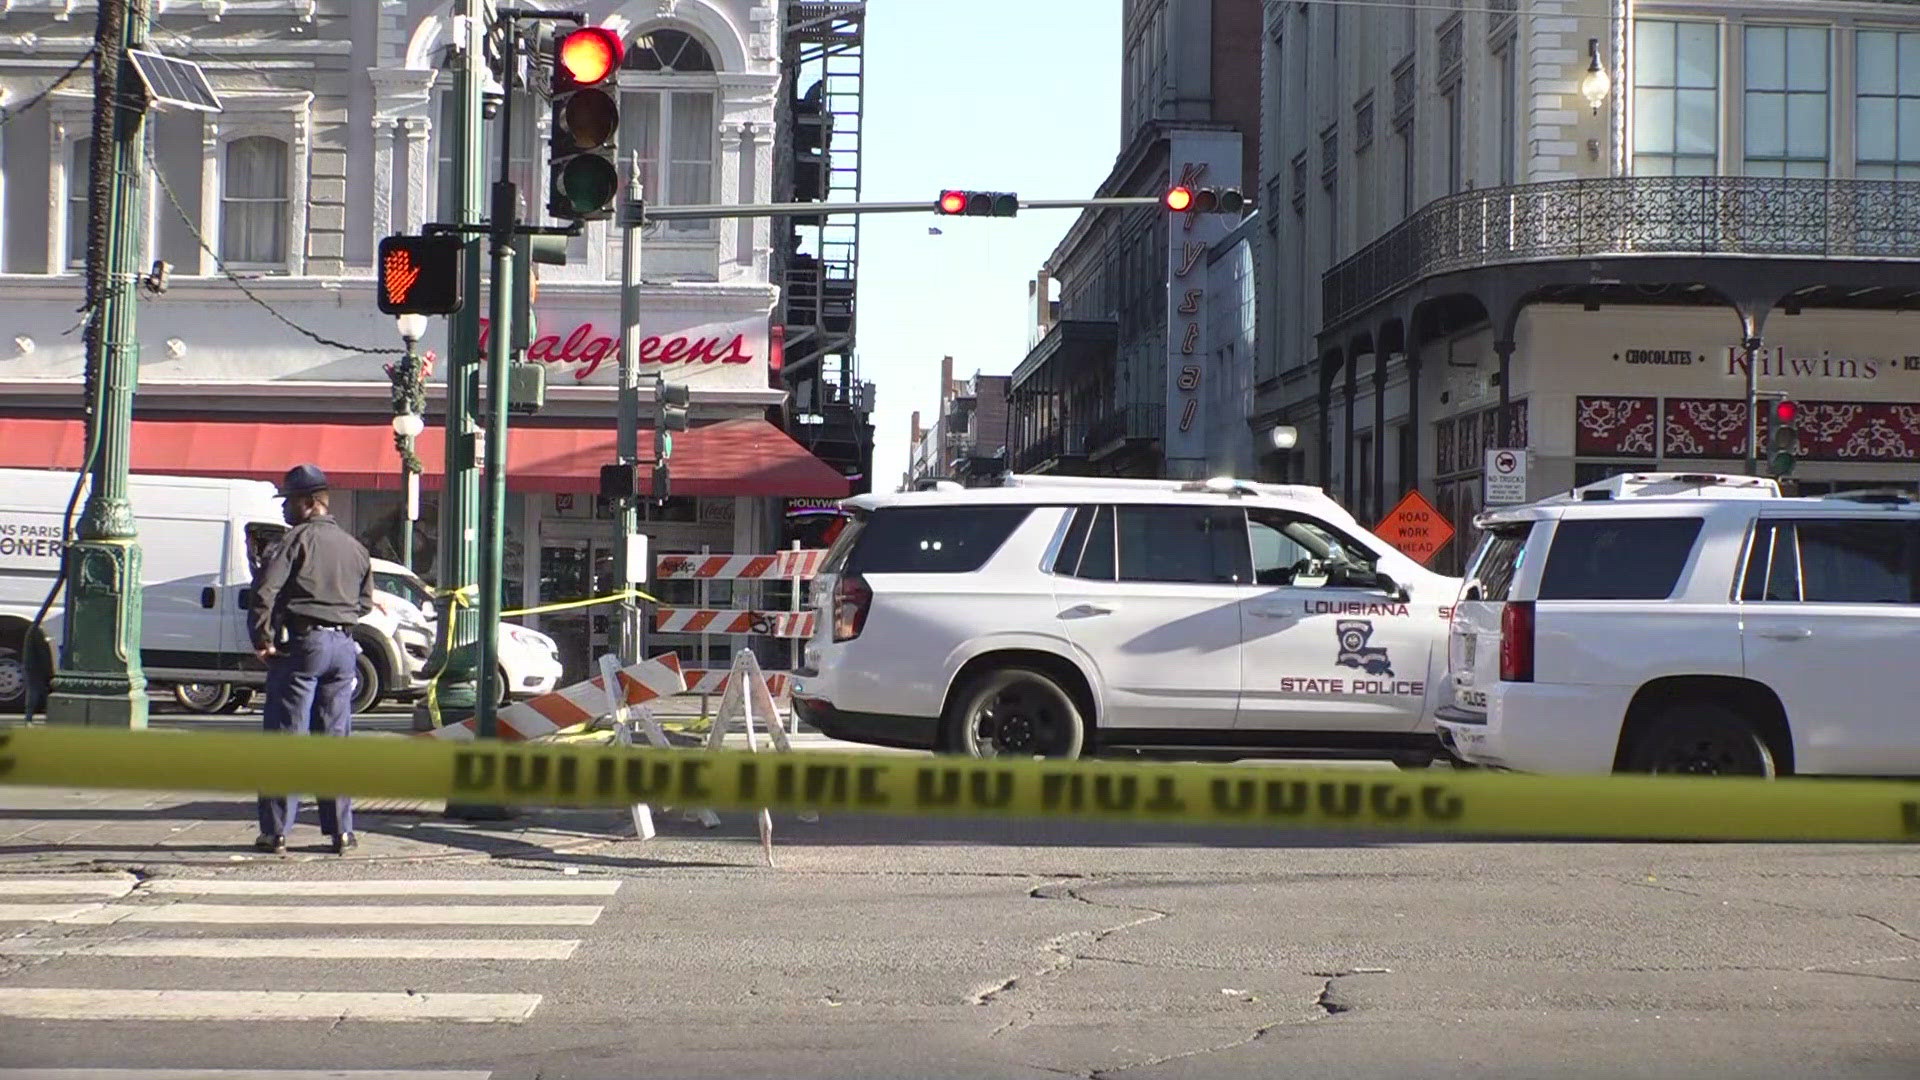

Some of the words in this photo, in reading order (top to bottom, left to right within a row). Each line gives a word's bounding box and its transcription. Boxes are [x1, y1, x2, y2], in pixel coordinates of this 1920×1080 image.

[1625, 349, 1692, 365] CHOCOLATES
[1727, 345, 1879, 379] Kilwins
[788, 498, 838, 508] HOLLYW
[1399, 511, 1429, 522] ROAD
[20, 525, 70, 538] PARIS
[1399, 527, 1429, 538] WORK
[0, 537, 63, 557] ONER
[1397, 542, 1433, 552] AHEAD
[1304, 599, 1410, 618] LOUISIANA
[1280, 677, 1343, 694] STATE
[1352, 679, 1424, 696] POLICE
